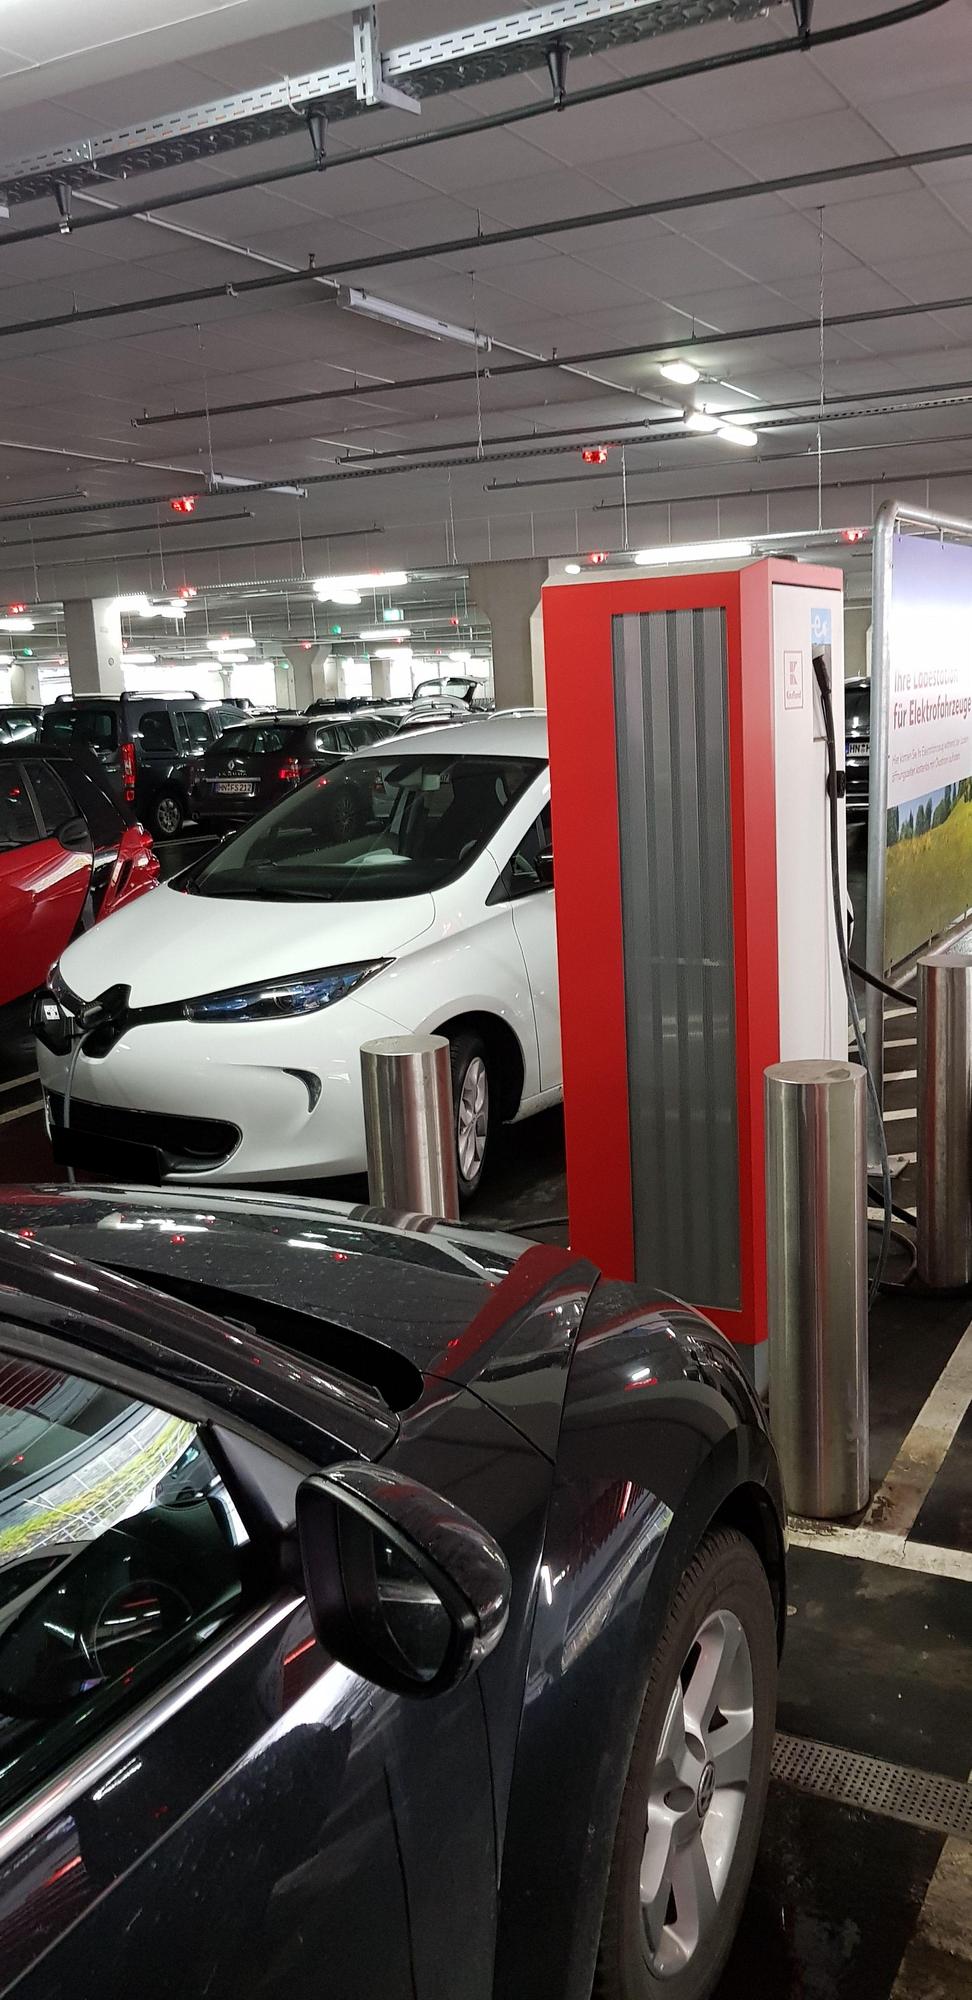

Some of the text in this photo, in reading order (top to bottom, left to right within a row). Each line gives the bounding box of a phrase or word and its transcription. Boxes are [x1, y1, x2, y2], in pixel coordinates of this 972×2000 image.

[894, 671, 912, 693] Ihre
[893, 694, 972, 730] für Elektrofahrzeuge
